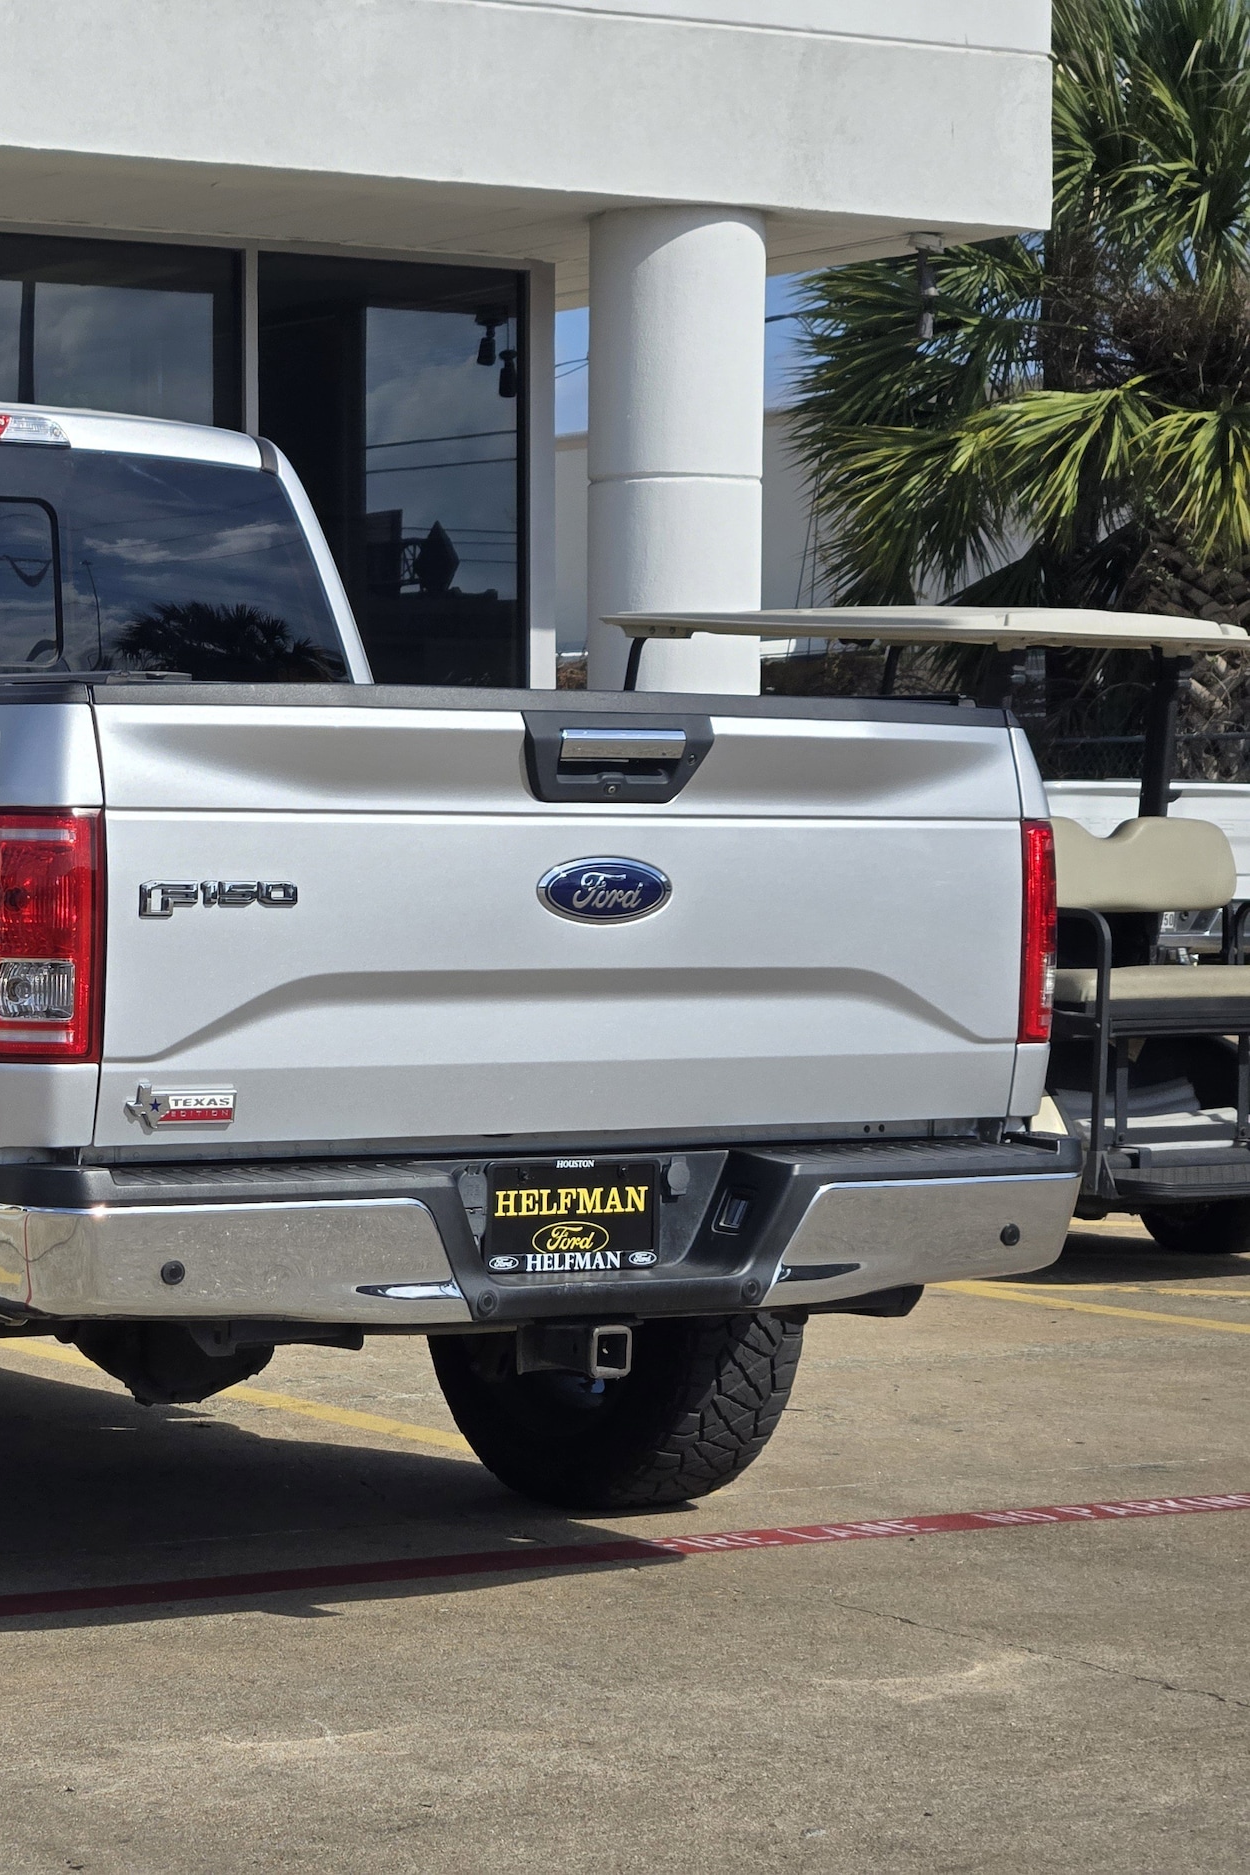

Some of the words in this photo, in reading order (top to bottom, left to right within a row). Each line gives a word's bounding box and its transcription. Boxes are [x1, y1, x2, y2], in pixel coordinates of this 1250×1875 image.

[572, 871, 644, 909] Ford
[171, 1097, 230, 1107] TEXAS
[171, 1109, 229, 1118] EDITION
[556, 1159, 595, 1169] HOUSTON
[494, 1186, 649, 1217] HELFMAN
[546, 1225, 595, 1250] Ford
[525, 1251, 623, 1272] HELFMAN
[637, 1532, 784, 1552] FIRE
[776, 1519, 937, 1541] LANE
